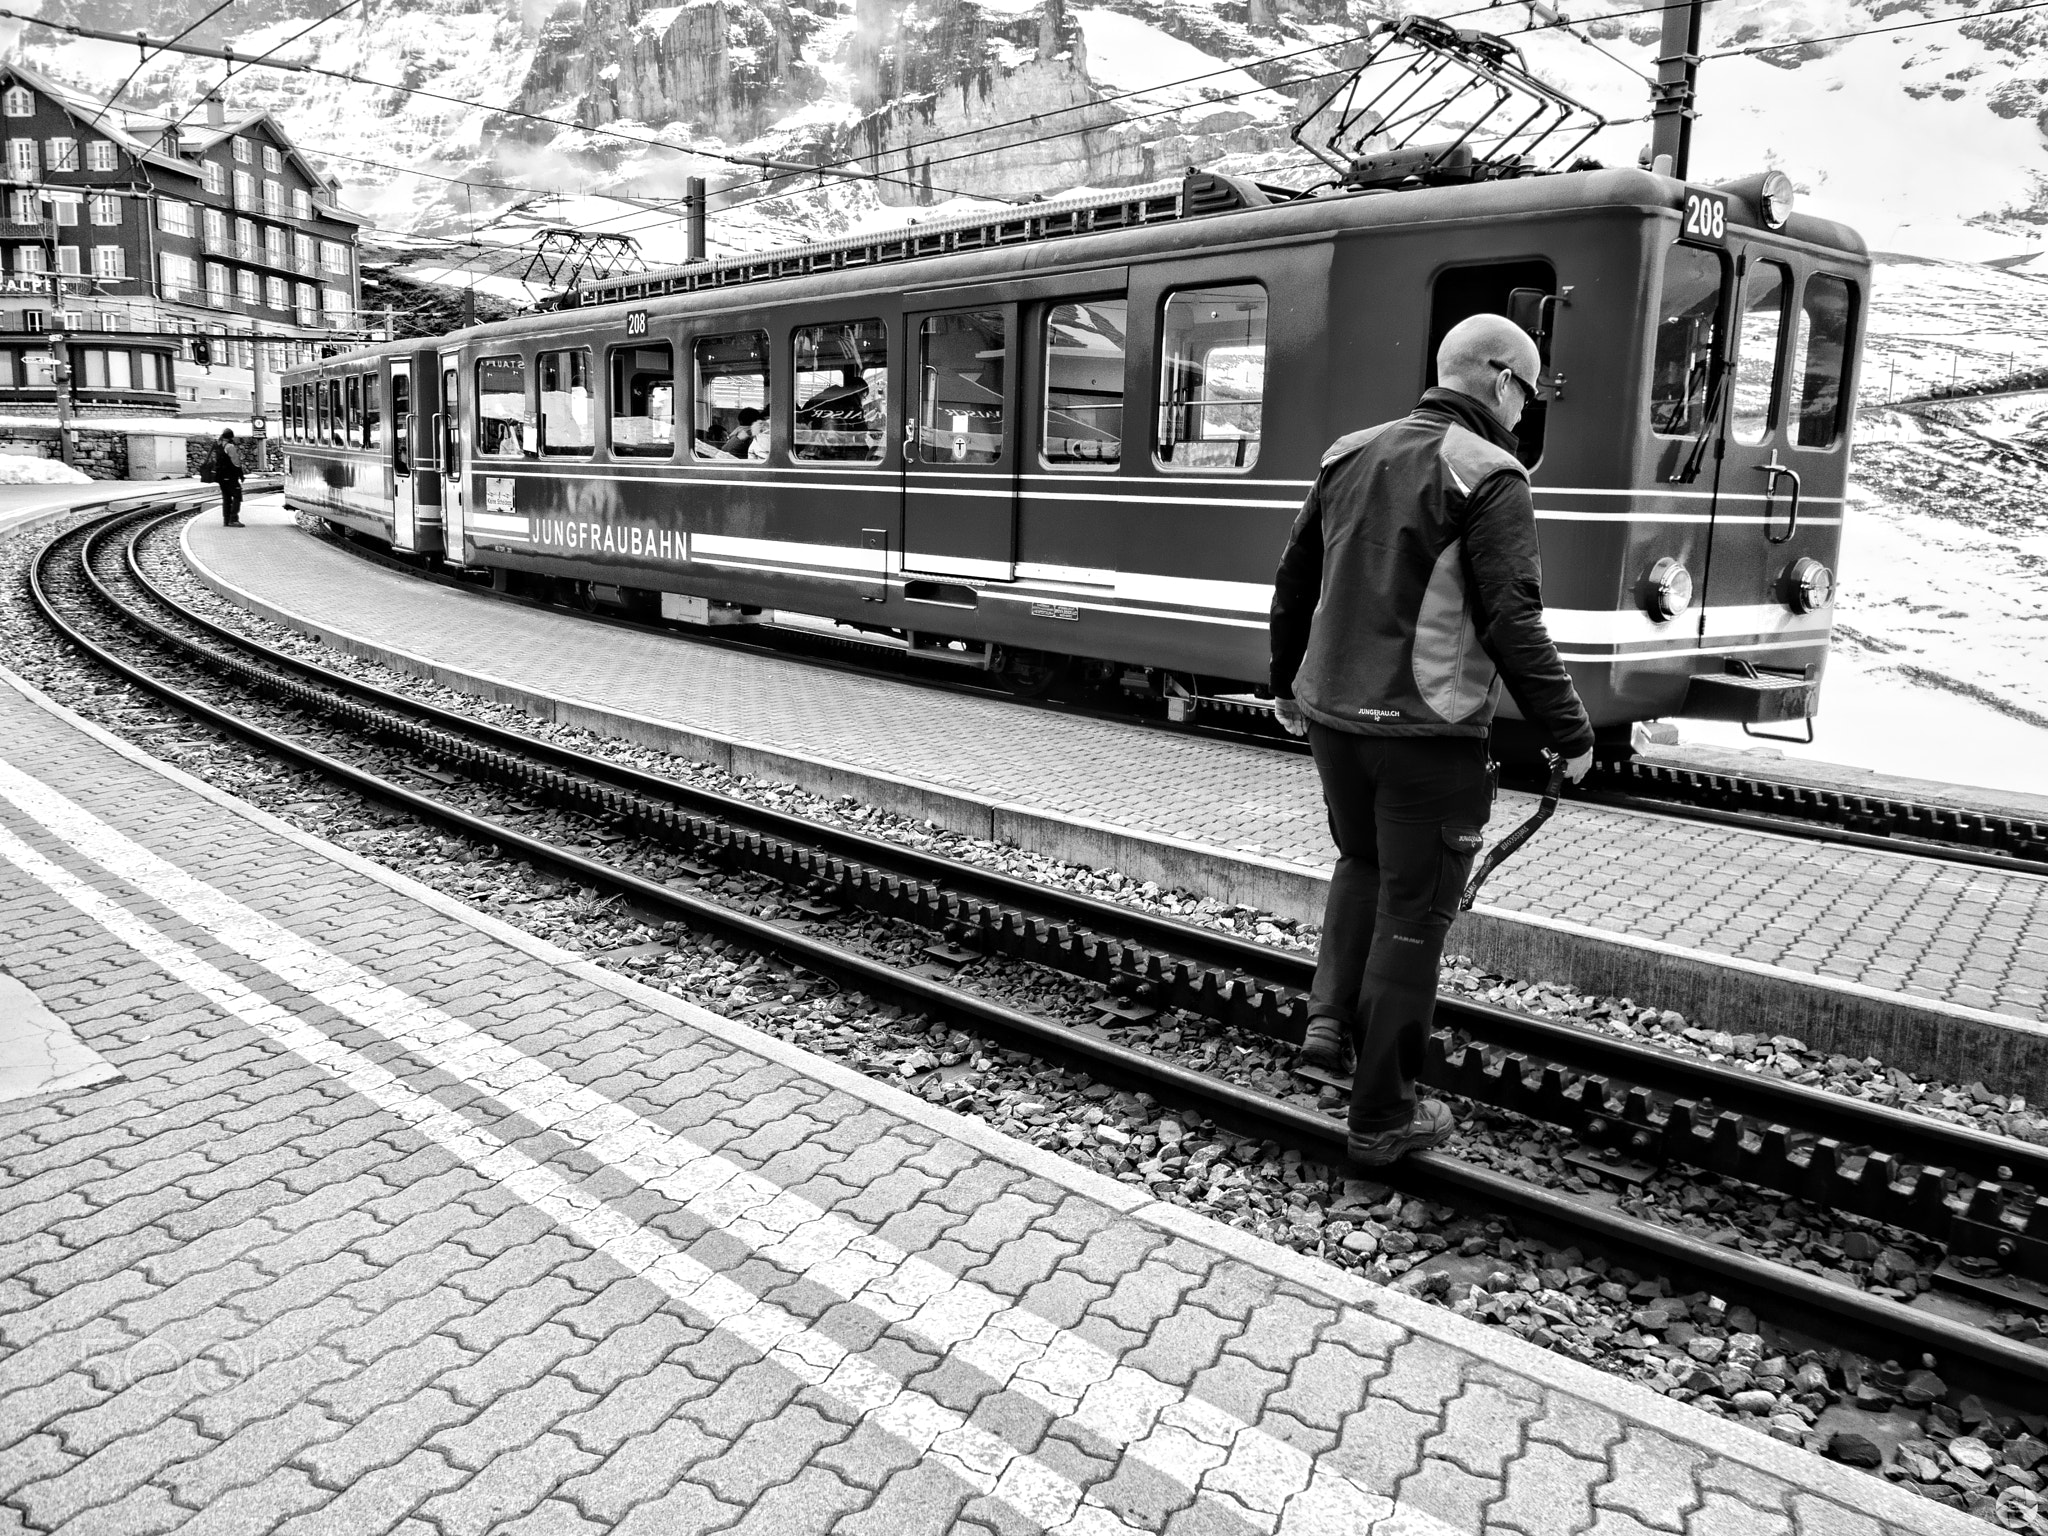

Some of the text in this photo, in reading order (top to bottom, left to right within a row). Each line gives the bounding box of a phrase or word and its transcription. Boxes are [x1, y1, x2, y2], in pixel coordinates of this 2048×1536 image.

[1687, 195, 1724, 239] 208
[628, 312, 646, 335] 208
[532, 518, 687, 561] JUNGFRAUBAHN
